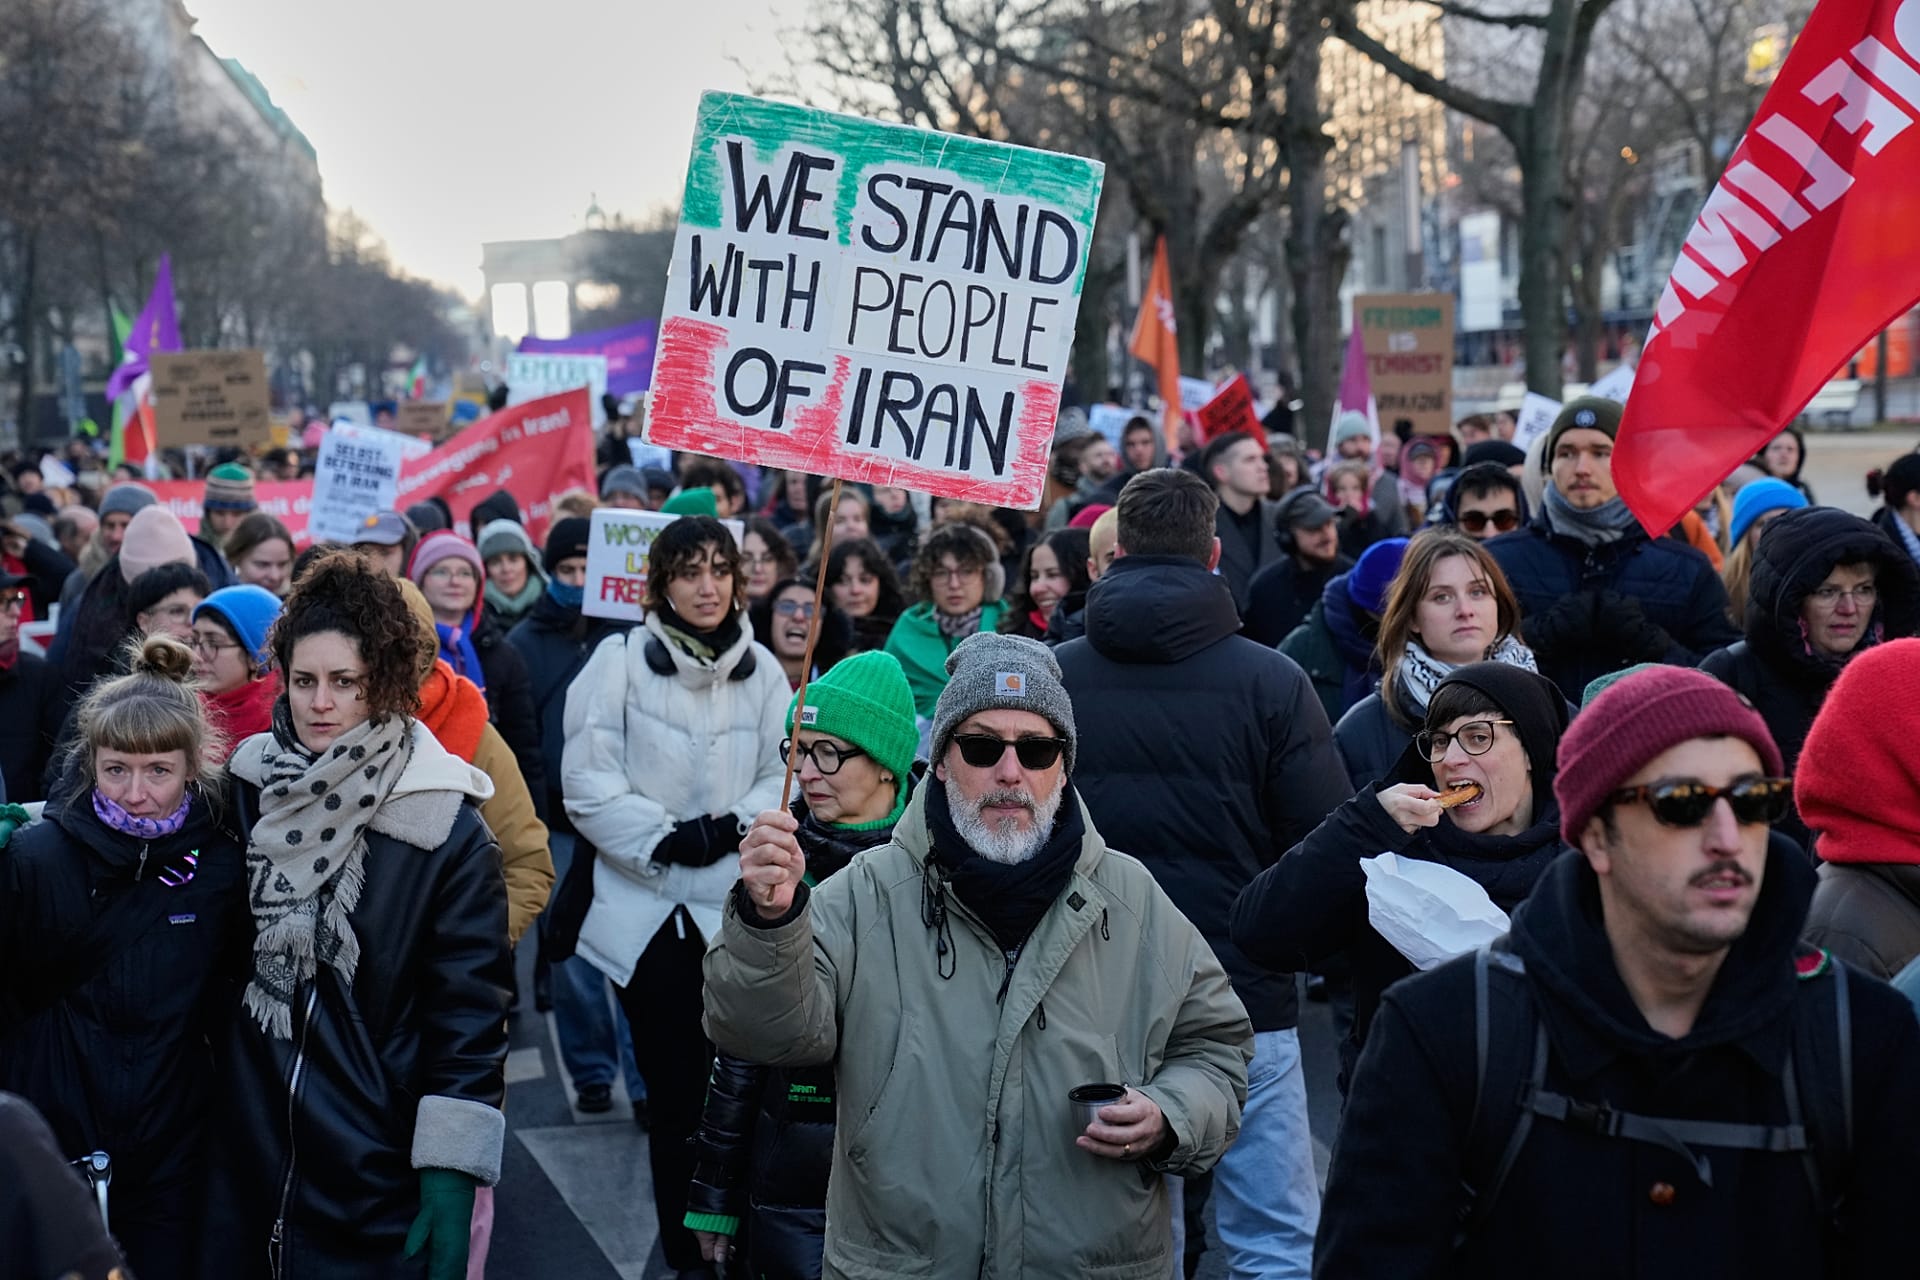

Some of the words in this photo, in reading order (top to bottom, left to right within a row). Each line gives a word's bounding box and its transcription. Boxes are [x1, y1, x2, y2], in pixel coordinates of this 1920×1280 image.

[727, 141, 835, 240] WE
[861, 173, 1078, 285] STAND
[689, 234, 821, 332] WITH
[847, 266, 1059, 373] PEOPLE
[724, 347, 826, 429] OF
[845, 367, 1015, 476] IRAN
[603, 523, 661, 546] WOM
